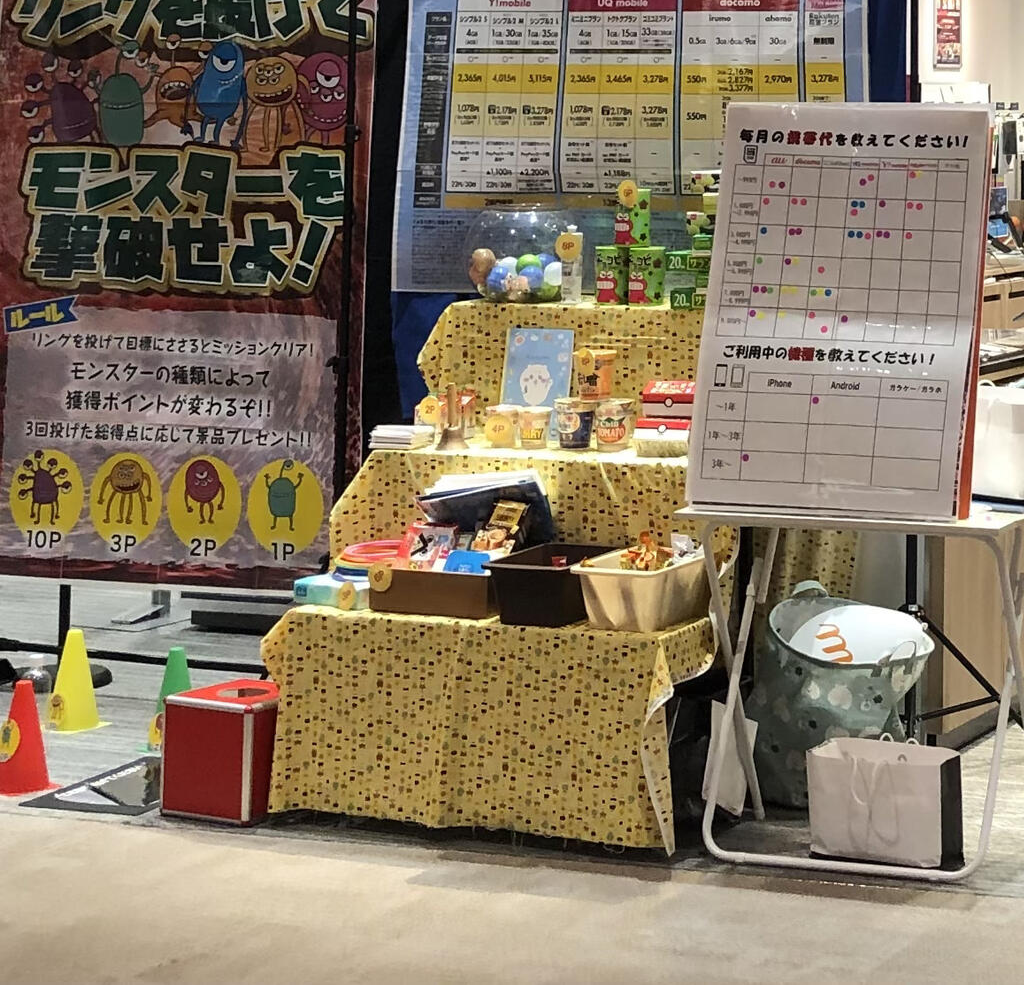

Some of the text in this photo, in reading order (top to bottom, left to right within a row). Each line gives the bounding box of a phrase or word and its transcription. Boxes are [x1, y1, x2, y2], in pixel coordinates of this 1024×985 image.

[709, 14, 731, 22] irumo
[26, 150, 345, 219] モンスターを
[28, 216, 330, 289] 撃破せよ!
[10, 302, 65, 329] ルール
[32, 332, 314, 358] リングを投げて目標にささるとミッションクリア!
[70, 362, 271, 388] モンスターの種類によって
[767, 379, 792, 389] iPhone
[830, 381, 860, 391] Android
[66, 390, 272, 419] 獲得ポイントが変わるぞ!!
[25, 420, 312, 448] 3回投げた総得点に応じて景品プレゼント!!
[26, 530, 61, 549] 10P
[110, 534, 137, 553] 3P
[189, 538, 217, 557] 2P
[271, 542, 295, 561] 1P
